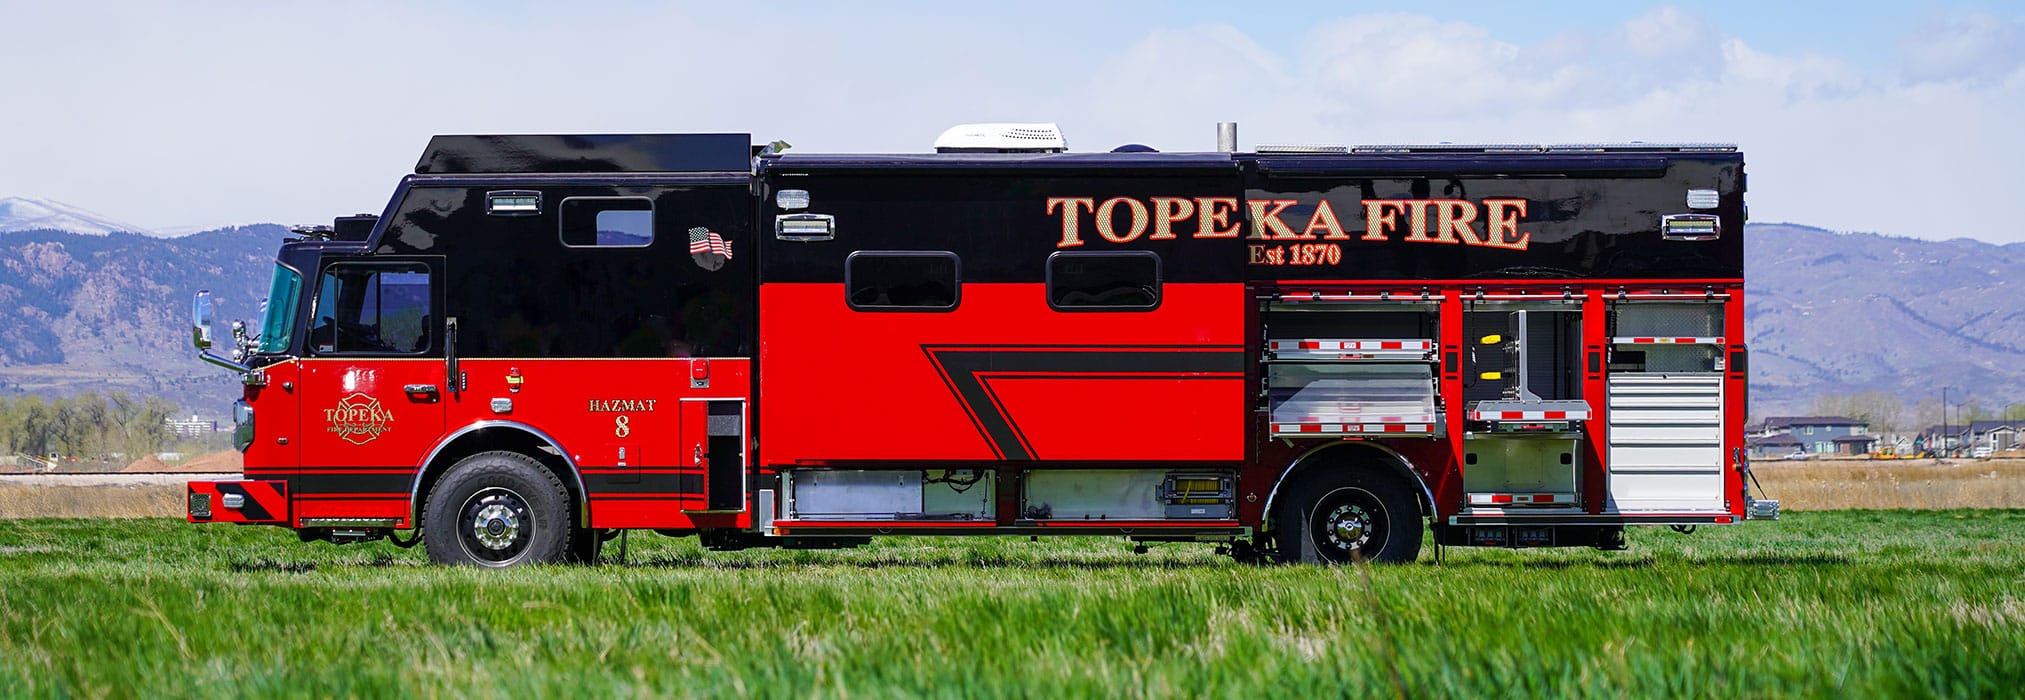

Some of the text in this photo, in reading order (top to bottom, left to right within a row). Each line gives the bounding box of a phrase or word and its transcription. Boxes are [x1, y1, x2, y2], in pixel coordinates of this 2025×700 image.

[1046, 196, 1530, 251] TOPEKA FIRE
[1248, 243, 1342, 266] Est 1870
[323, 408, 394, 422] TOPEKA
[589, 399, 657, 412] HAZMAT
[615, 414, 630, 438] 8
